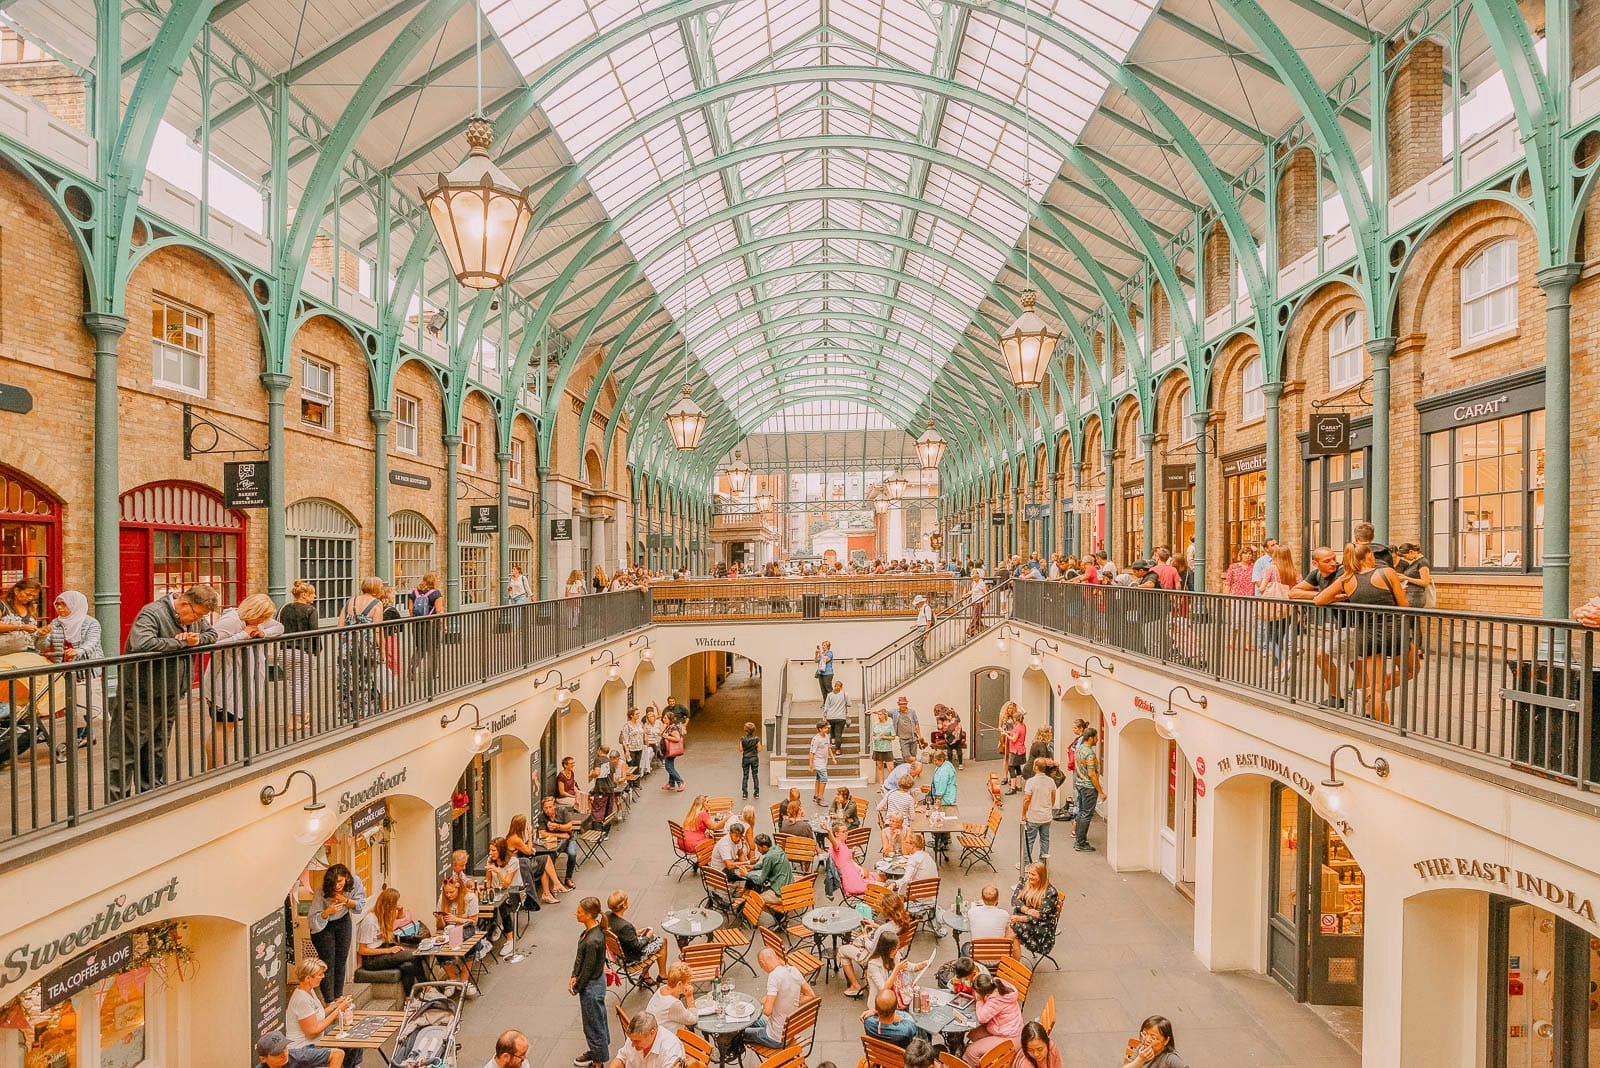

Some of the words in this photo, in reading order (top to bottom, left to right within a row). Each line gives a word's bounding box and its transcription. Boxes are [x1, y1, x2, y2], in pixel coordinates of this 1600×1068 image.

[1453, 399, 1501, 420] CARAT
[1236, 456, 1262, 471] Venchi
[695, 637, 736, 647] Whittard
[491, 710, 517, 734] Italiani
[1235, 754, 1260, 766] EAST
[1260, 755, 1291, 779] INDIA
[339, 766, 407, 815] Sweetheart
[1413, 858, 1454, 879] THE
[1455, 857, 1511, 885] EAST
[1515, 869, 1597, 924] INDIA
[0, 876, 179, 989] Sweetheart
[68, 963, 100, 989] COFFEE
[100, 958, 108, 971] &
[108, 946, 130, 967] LOVE
